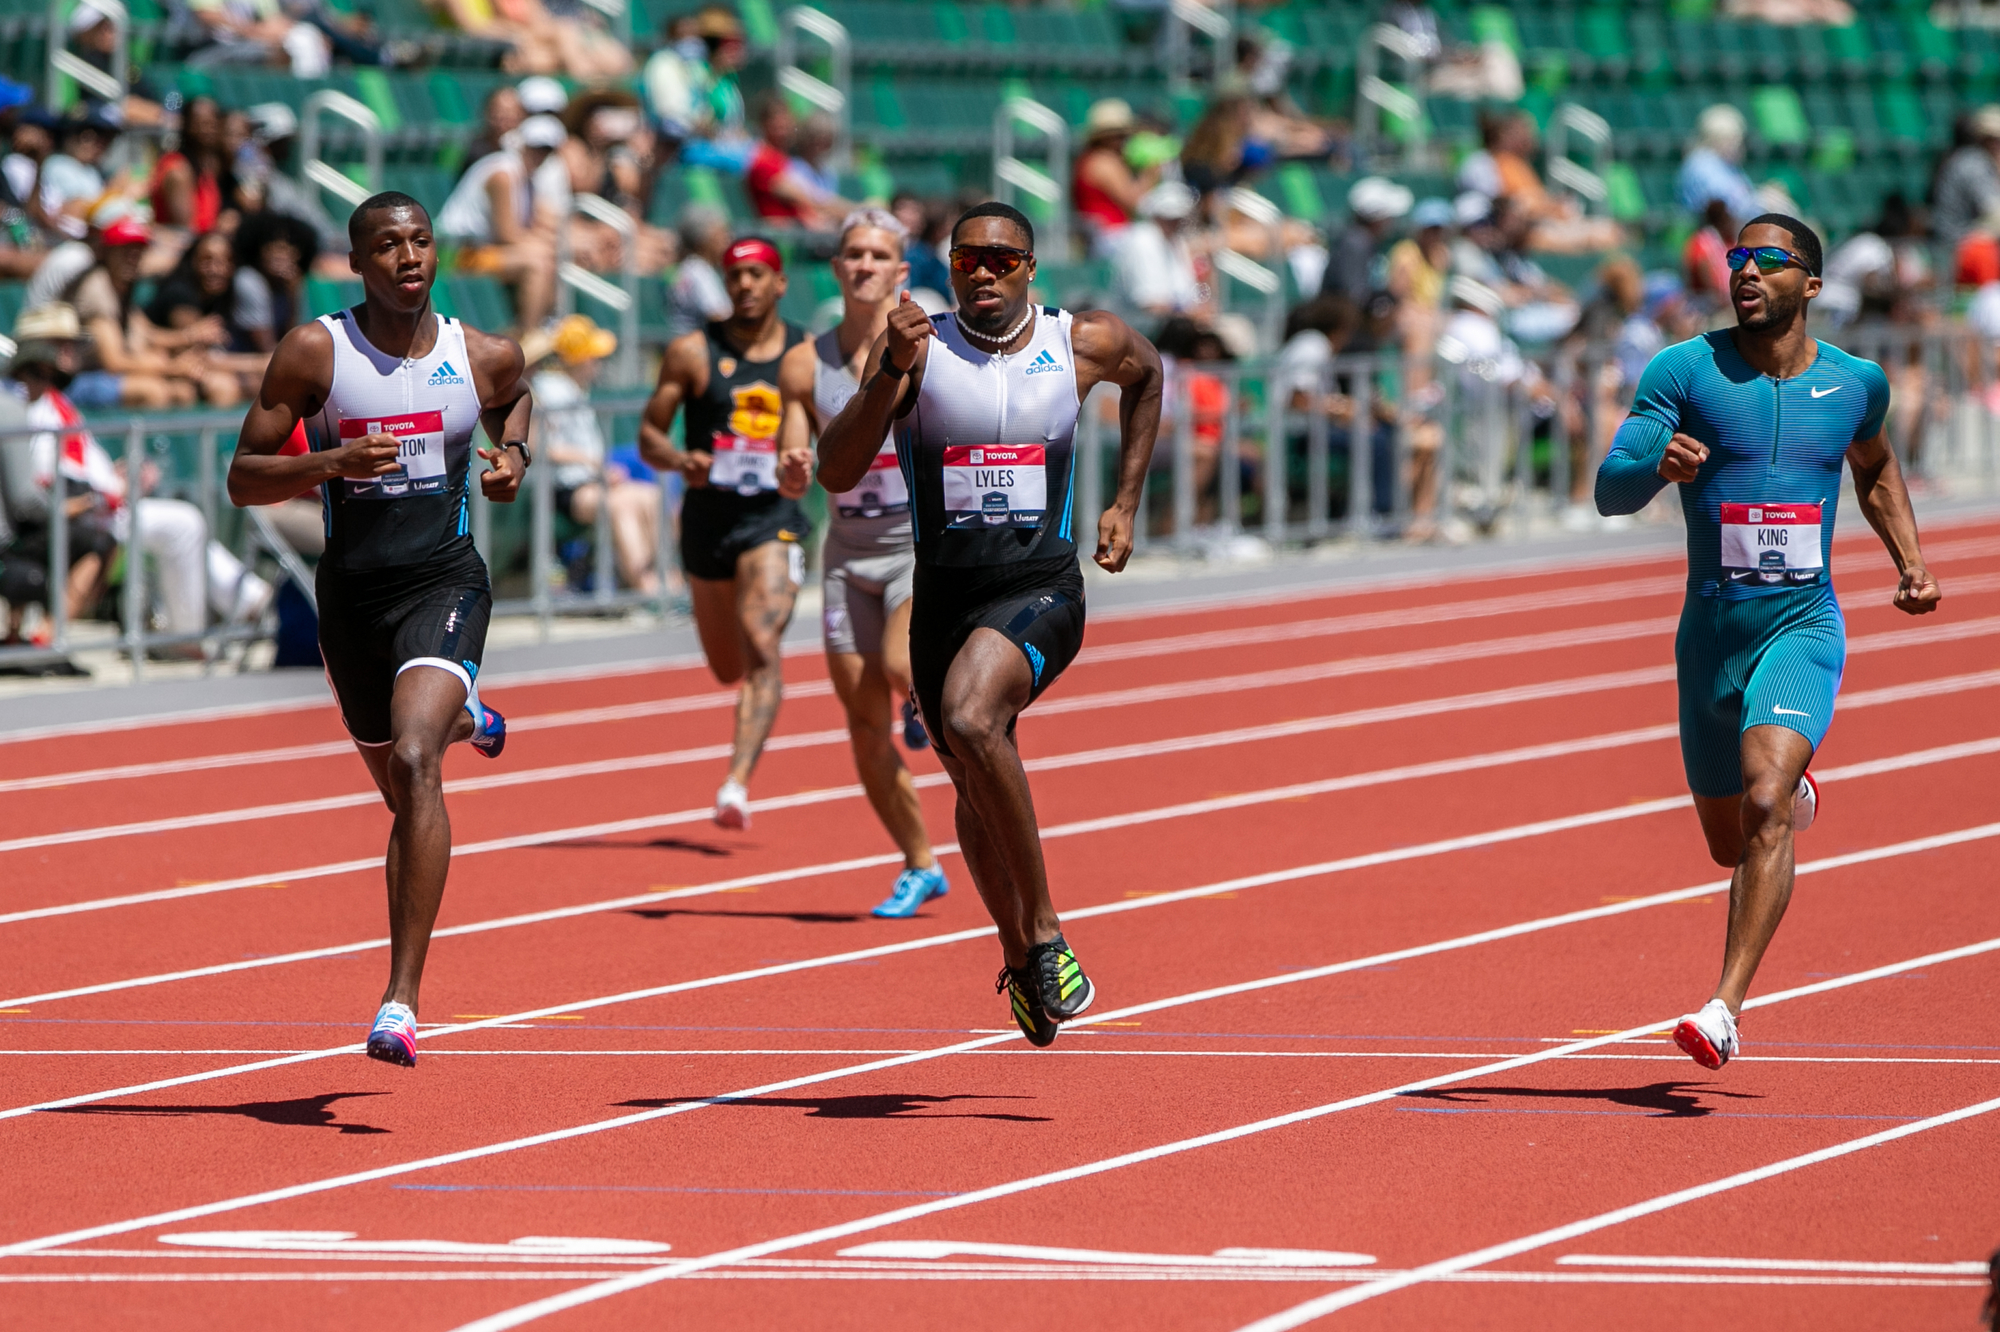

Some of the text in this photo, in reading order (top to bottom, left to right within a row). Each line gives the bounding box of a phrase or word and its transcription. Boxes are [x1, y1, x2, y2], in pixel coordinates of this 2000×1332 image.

[1026, 363, 1064, 375] adidas
[428, 376, 465, 386] adidas
[384, 422, 415, 431] TOYOTA
[986, 452, 1018, 460] TOYOTA
[975, 469, 1015, 487] LYLES
[1765, 511, 1797, 519] TOYOTA
[1757, 528, 1788, 546] KING
